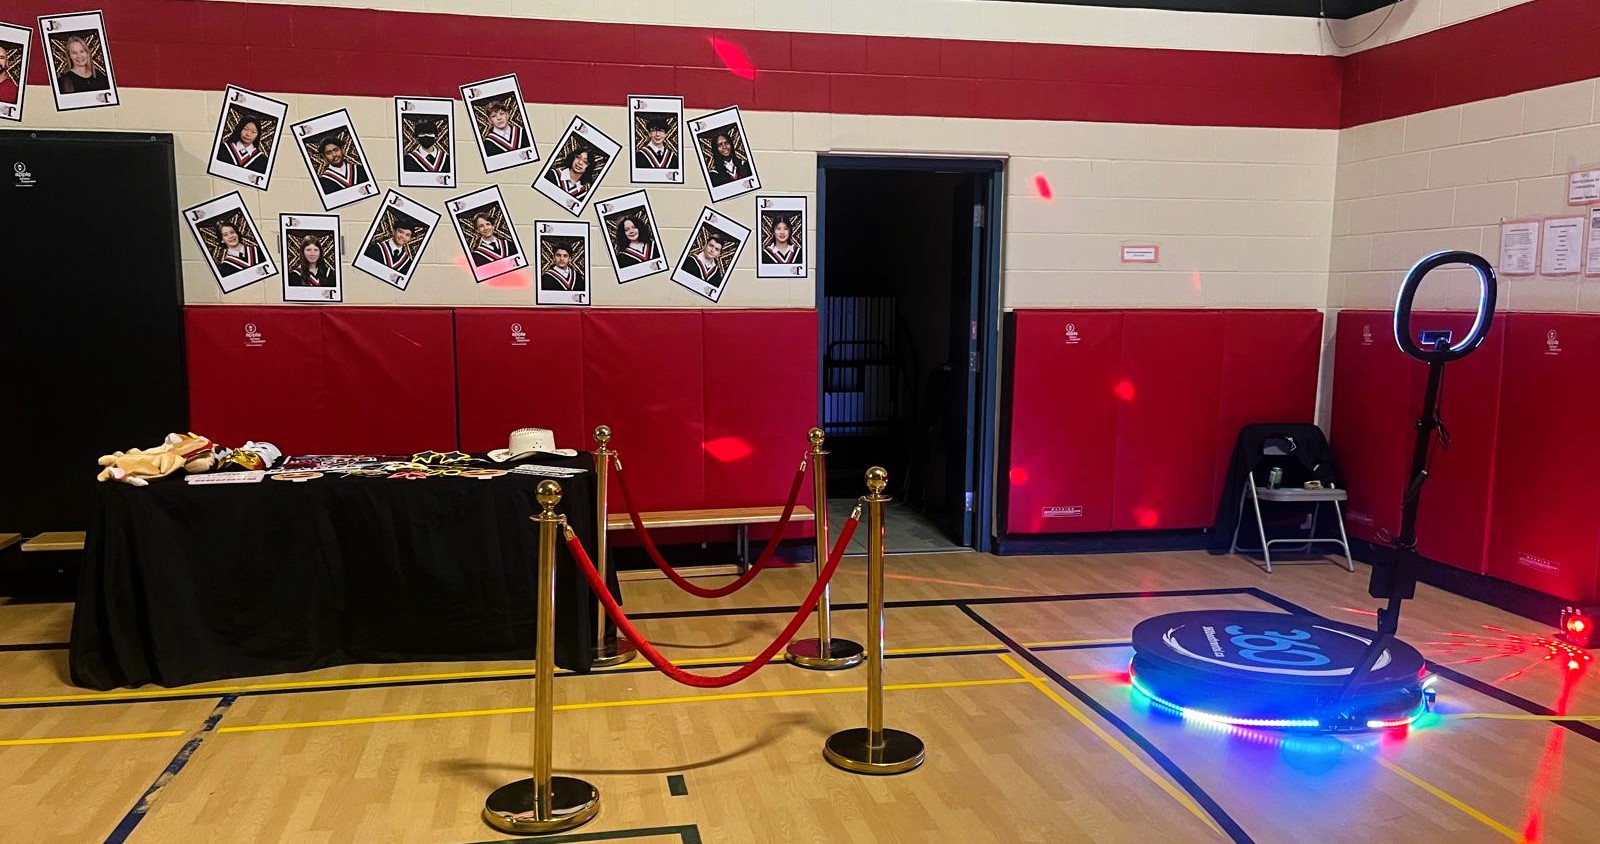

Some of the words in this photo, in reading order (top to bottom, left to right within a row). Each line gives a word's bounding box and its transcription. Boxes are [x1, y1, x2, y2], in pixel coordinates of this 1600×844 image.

[47, 20, 54, 31] J
[104, 92, 111, 103] J
[231, 92, 240, 102] J
[468, 88, 475, 99] J
[401, 101, 408, 111] J
[634, 100, 640, 110] J
[7, 106, 16, 117] J
[299, 125, 306, 136] J
[575, 123, 584, 131] J
[694, 122, 701, 132] J
[526, 149, 532, 160] J
[255, 176, 264, 185] J
[444, 175, 450, 185] J
[672, 171, 679, 181] J
[748, 178, 754, 188] J
[365, 184, 371, 195] J
[389, 196, 399, 205] J
[761, 199, 767, 208] J
[453, 202, 460, 212] J
[570, 202, 579, 210] J
[601, 204, 608, 214] J
[192, 210, 199, 221] J
[705, 212, 713, 221] J
[285, 217, 292, 227] J
[540, 224, 547, 233] J
[514, 256, 520, 266] J
[656, 260, 662, 270] J
[262, 264, 269, 275] J
[797, 266, 803, 275] J
[394, 276, 404, 284] J
[329, 290, 336, 299] J
[708, 289, 717, 297] J
[579, 294, 585, 303] J
[1225, 625, 1331, 666] 360
